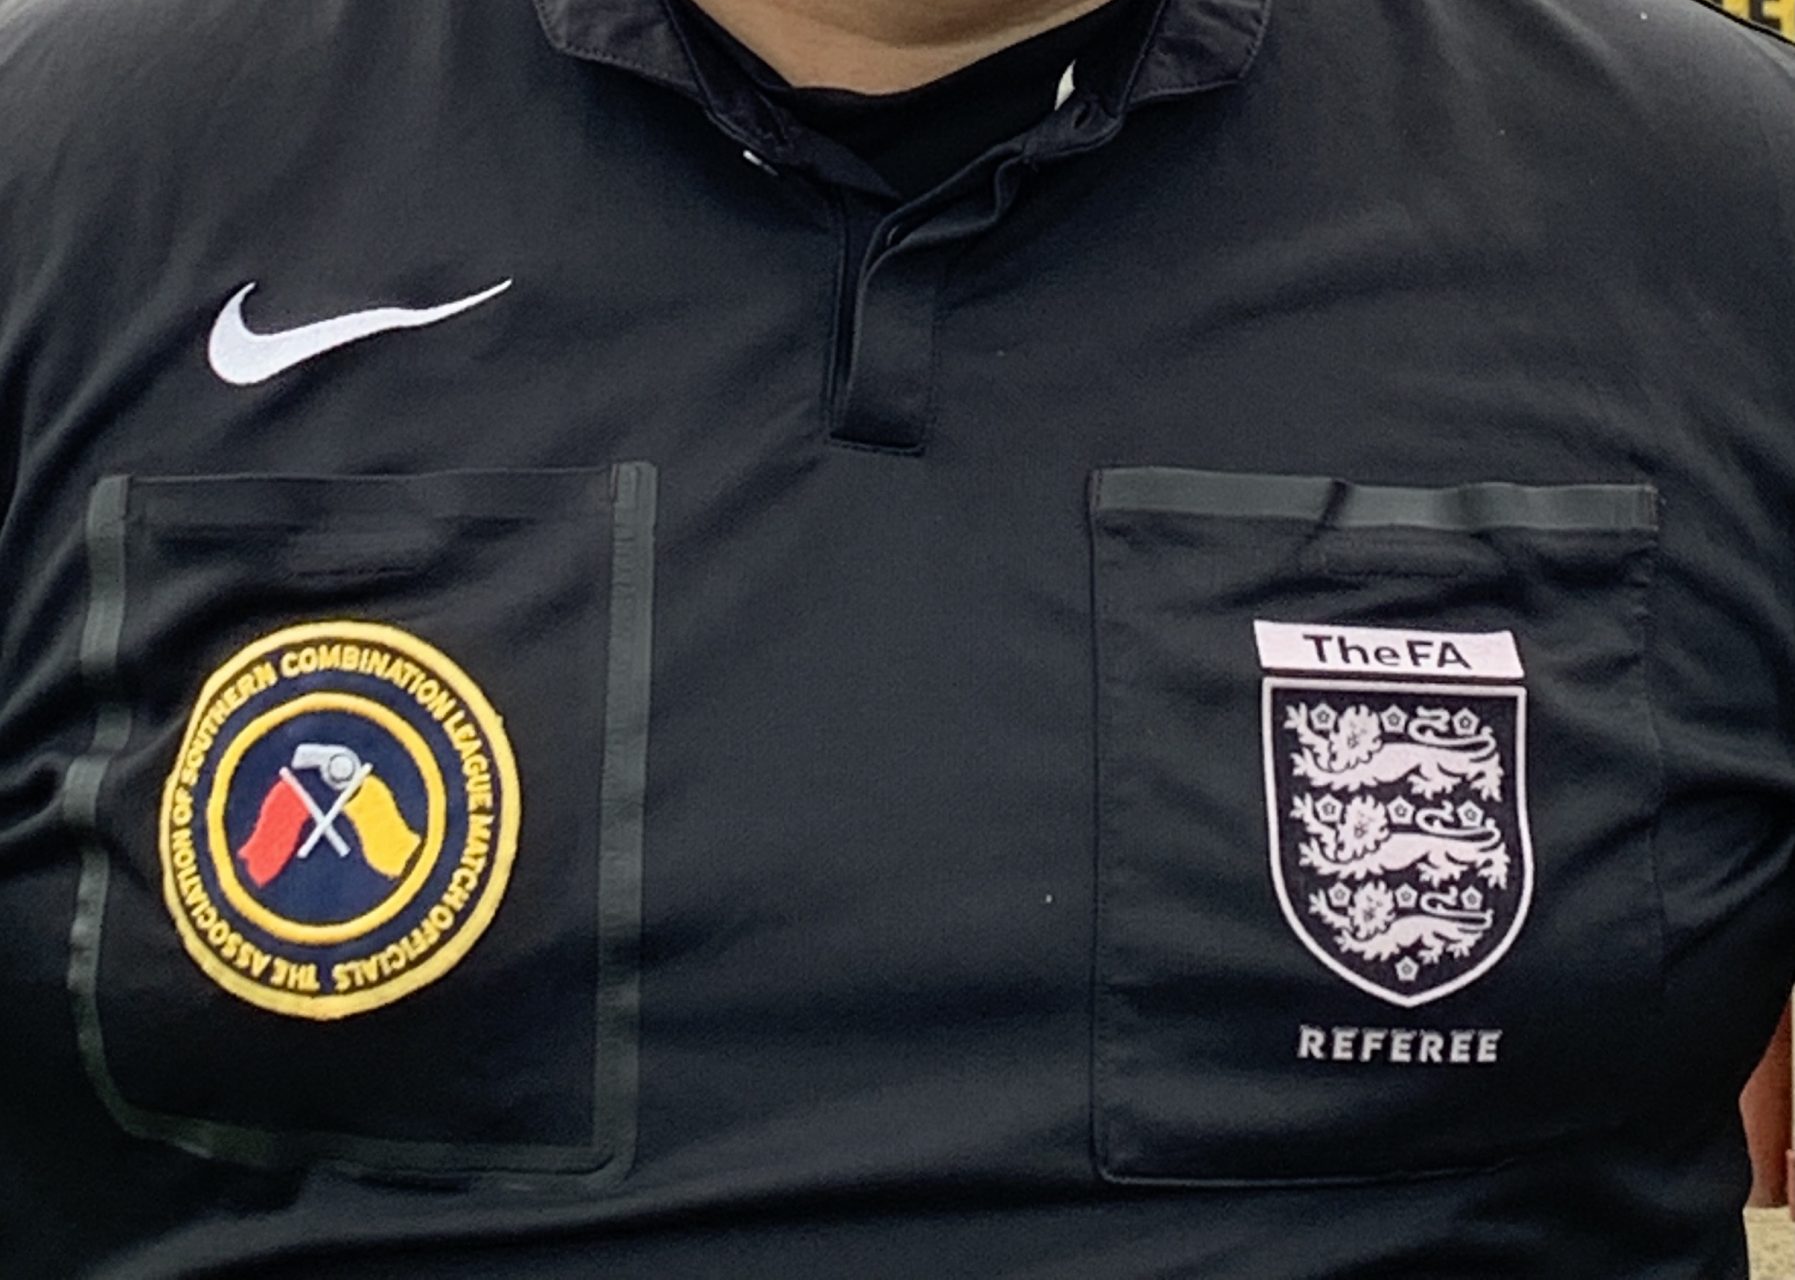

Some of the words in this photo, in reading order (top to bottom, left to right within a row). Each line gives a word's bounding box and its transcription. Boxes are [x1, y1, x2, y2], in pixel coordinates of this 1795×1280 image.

[180, 662, 278, 786] SOUTHERN
[280, 644, 457, 720] COMBINATION
[442, 710, 494, 811] LEAGUE
[172, 786, 194, 825] OF
[171, 828, 272, 977] ASSOCIATION
[442, 814, 494, 912] MATCH
[270, 957, 320, 990] THE
[331, 904, 454, 991] OFFICIALS
[1297, 1023, 1503, 1063] REFEREE
